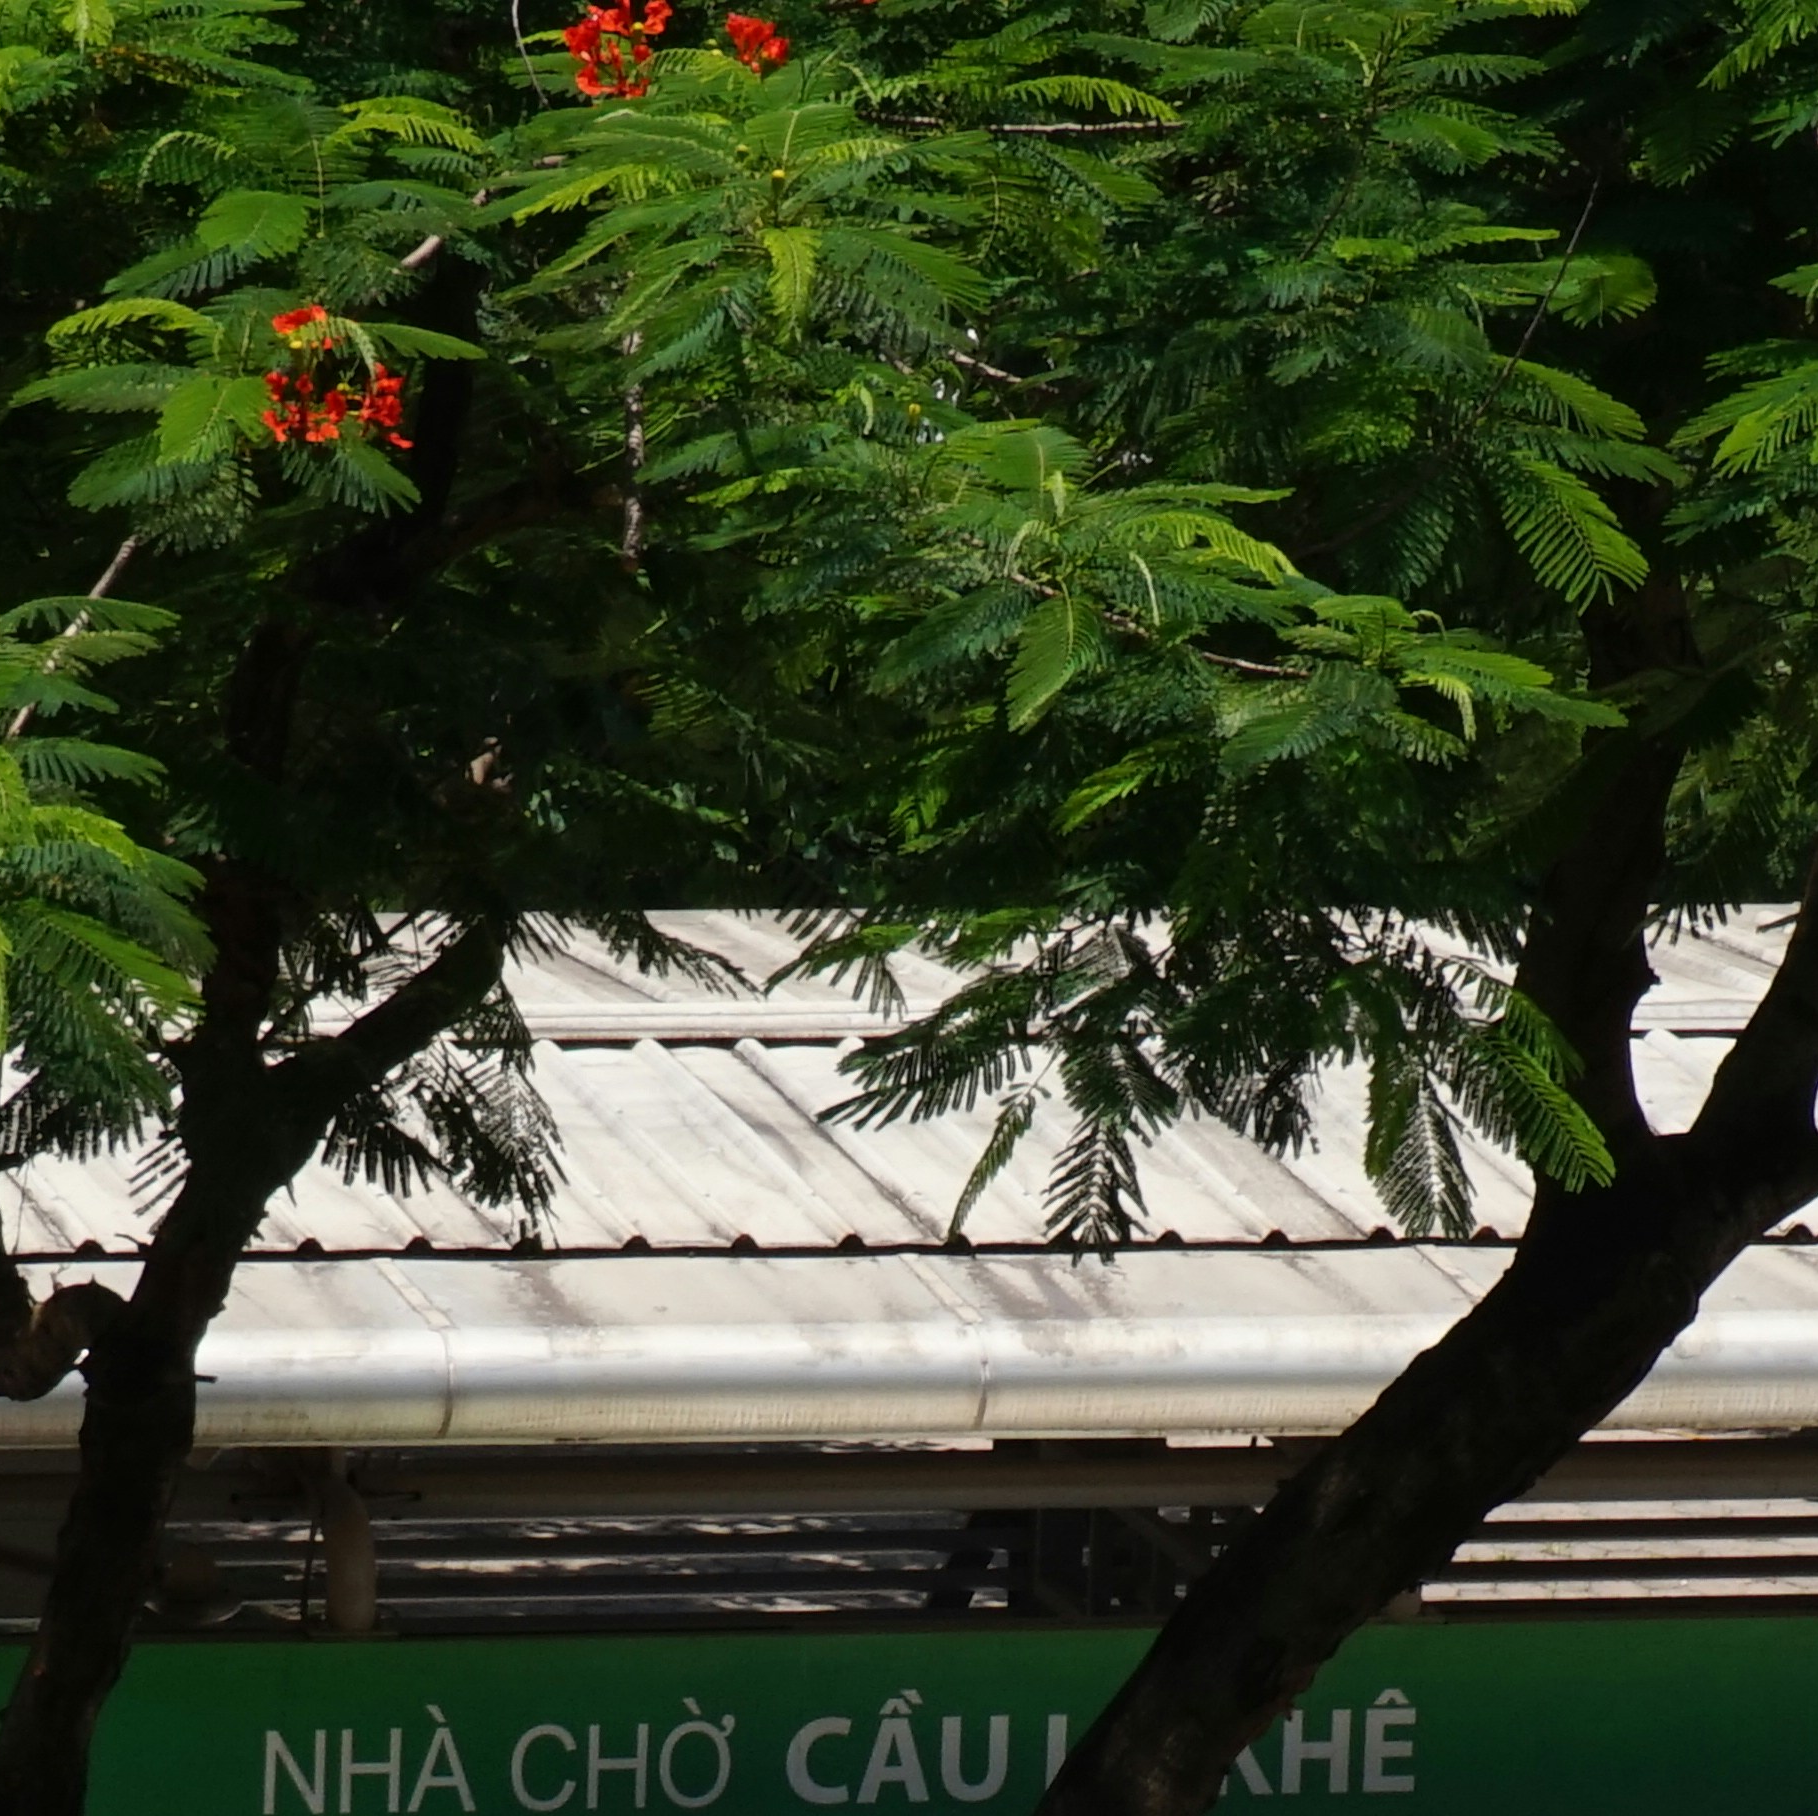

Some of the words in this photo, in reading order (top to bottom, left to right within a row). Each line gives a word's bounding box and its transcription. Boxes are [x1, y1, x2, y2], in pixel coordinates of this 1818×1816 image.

[263, 1704, 477, 1815] NHÀ
[511, 1697, 736, 1812] CHỜ
[785, 1689, 1010, 1804] CẦU
